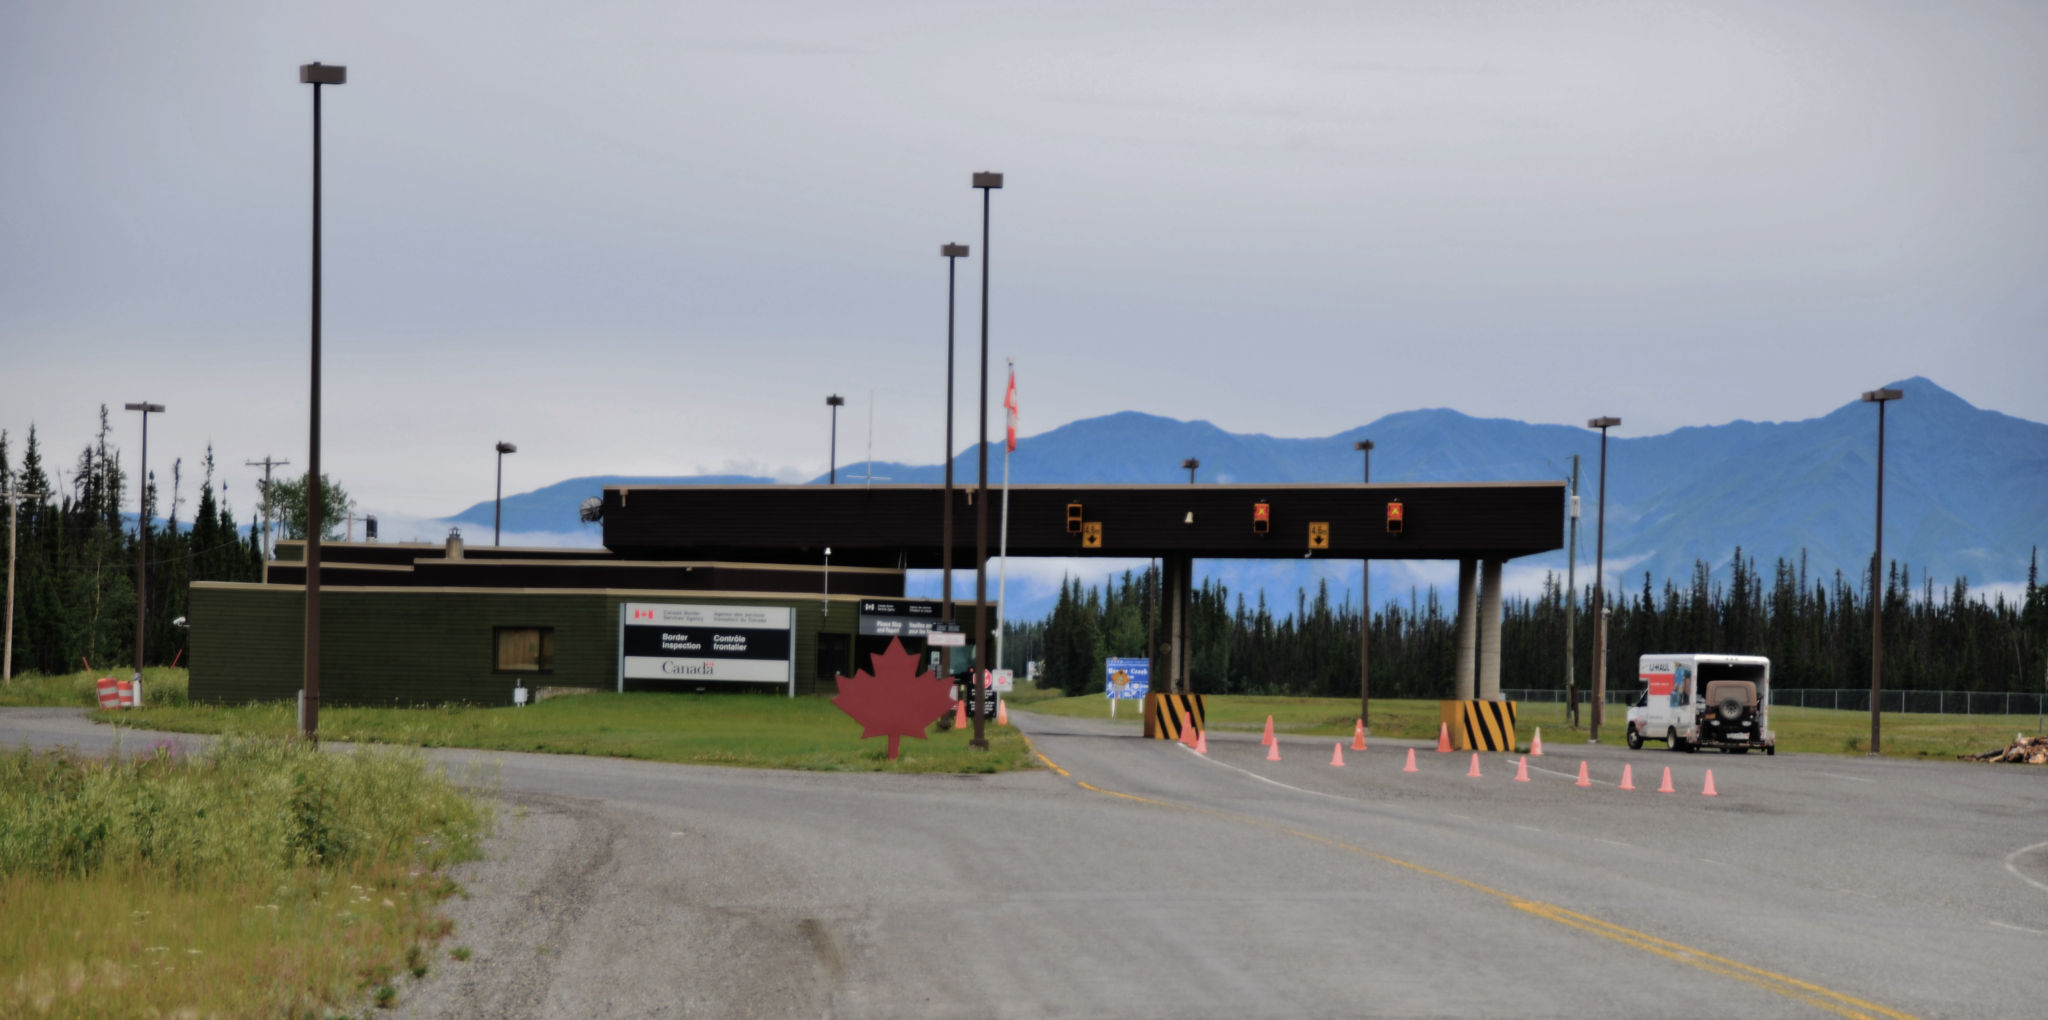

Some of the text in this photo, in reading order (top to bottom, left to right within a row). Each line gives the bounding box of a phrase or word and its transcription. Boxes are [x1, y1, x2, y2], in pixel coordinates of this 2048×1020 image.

[662, 633, 688, 641] Border
[713, 634, 746, 643] Contrôle
[662, 641, 701, 650] Inspection
[713, 643, 747, 651] frontalier
[662, 660, 714, 675] Canada
